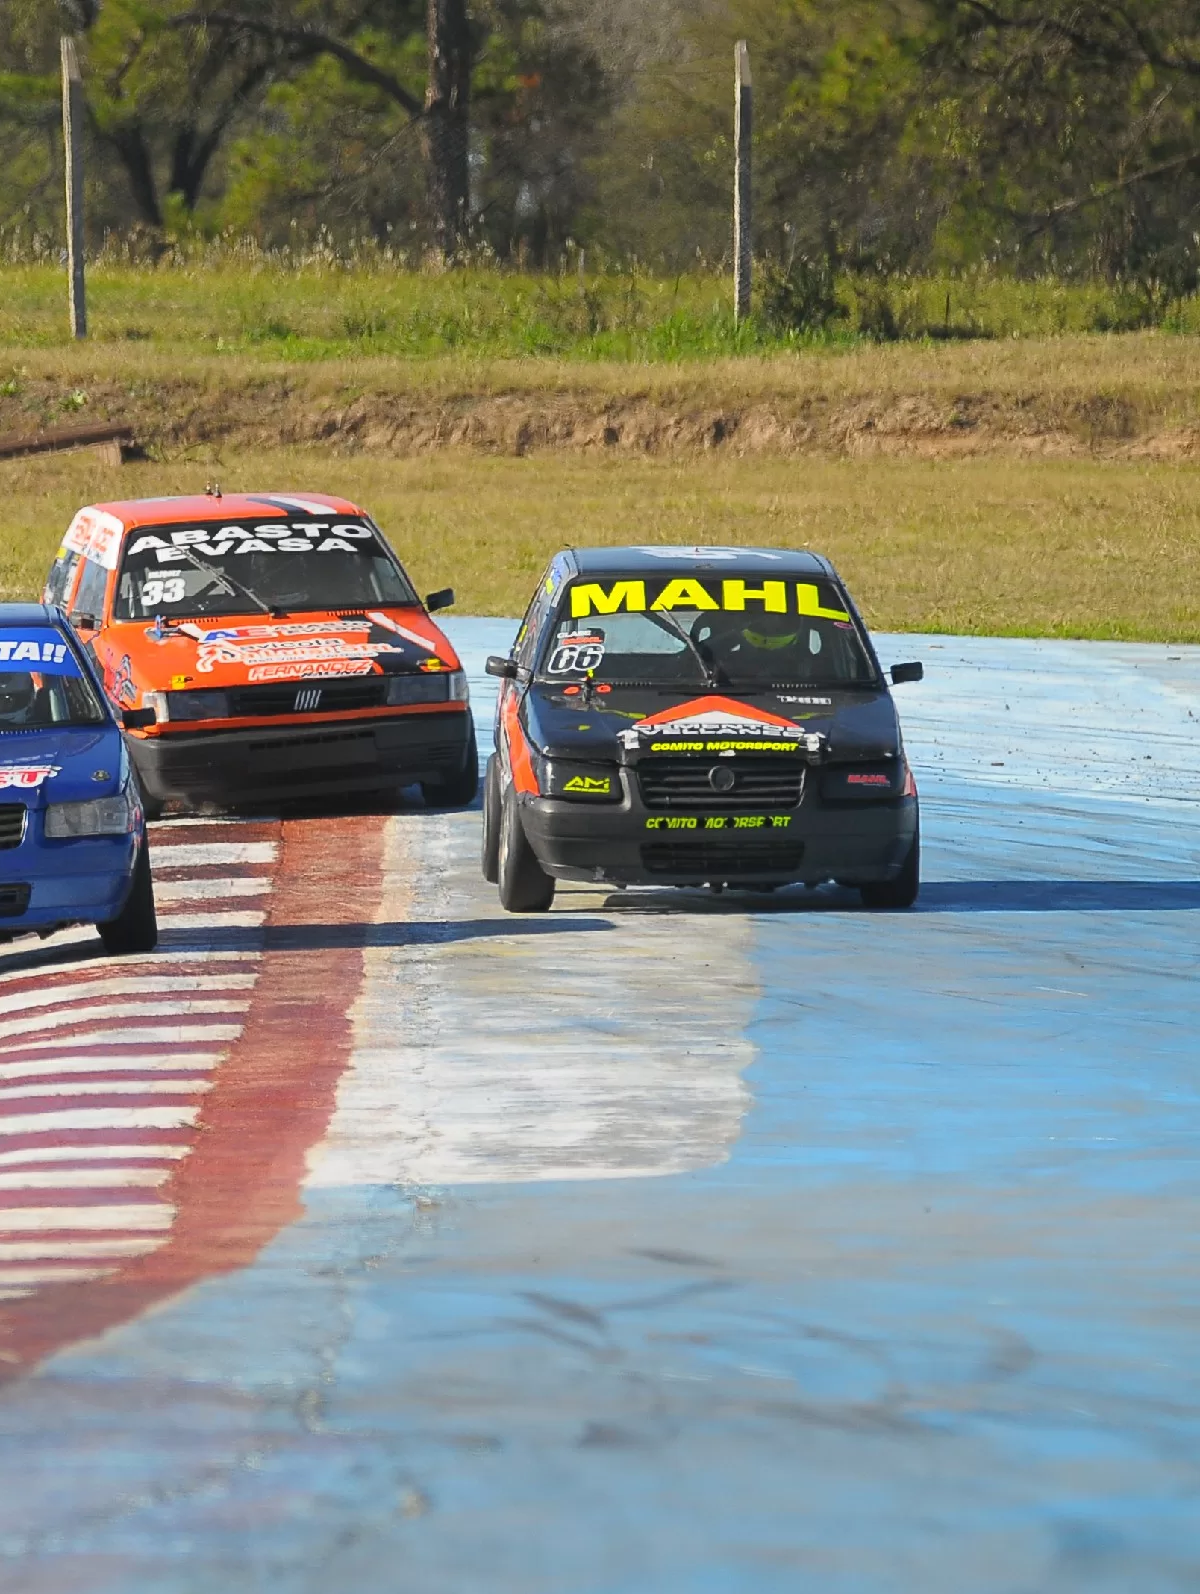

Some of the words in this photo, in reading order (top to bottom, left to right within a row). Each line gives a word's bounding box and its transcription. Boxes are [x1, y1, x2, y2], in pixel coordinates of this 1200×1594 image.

[127, 523, 373, 556] ABASTO
[155, 538, 358, 563] EVASA
[141, 578, 185, 606] 33
[570, 578, 851, 622] MAHL
[249, 661, 372, 677] FERNANDEZ
[547, 644, 605, 673] 66
